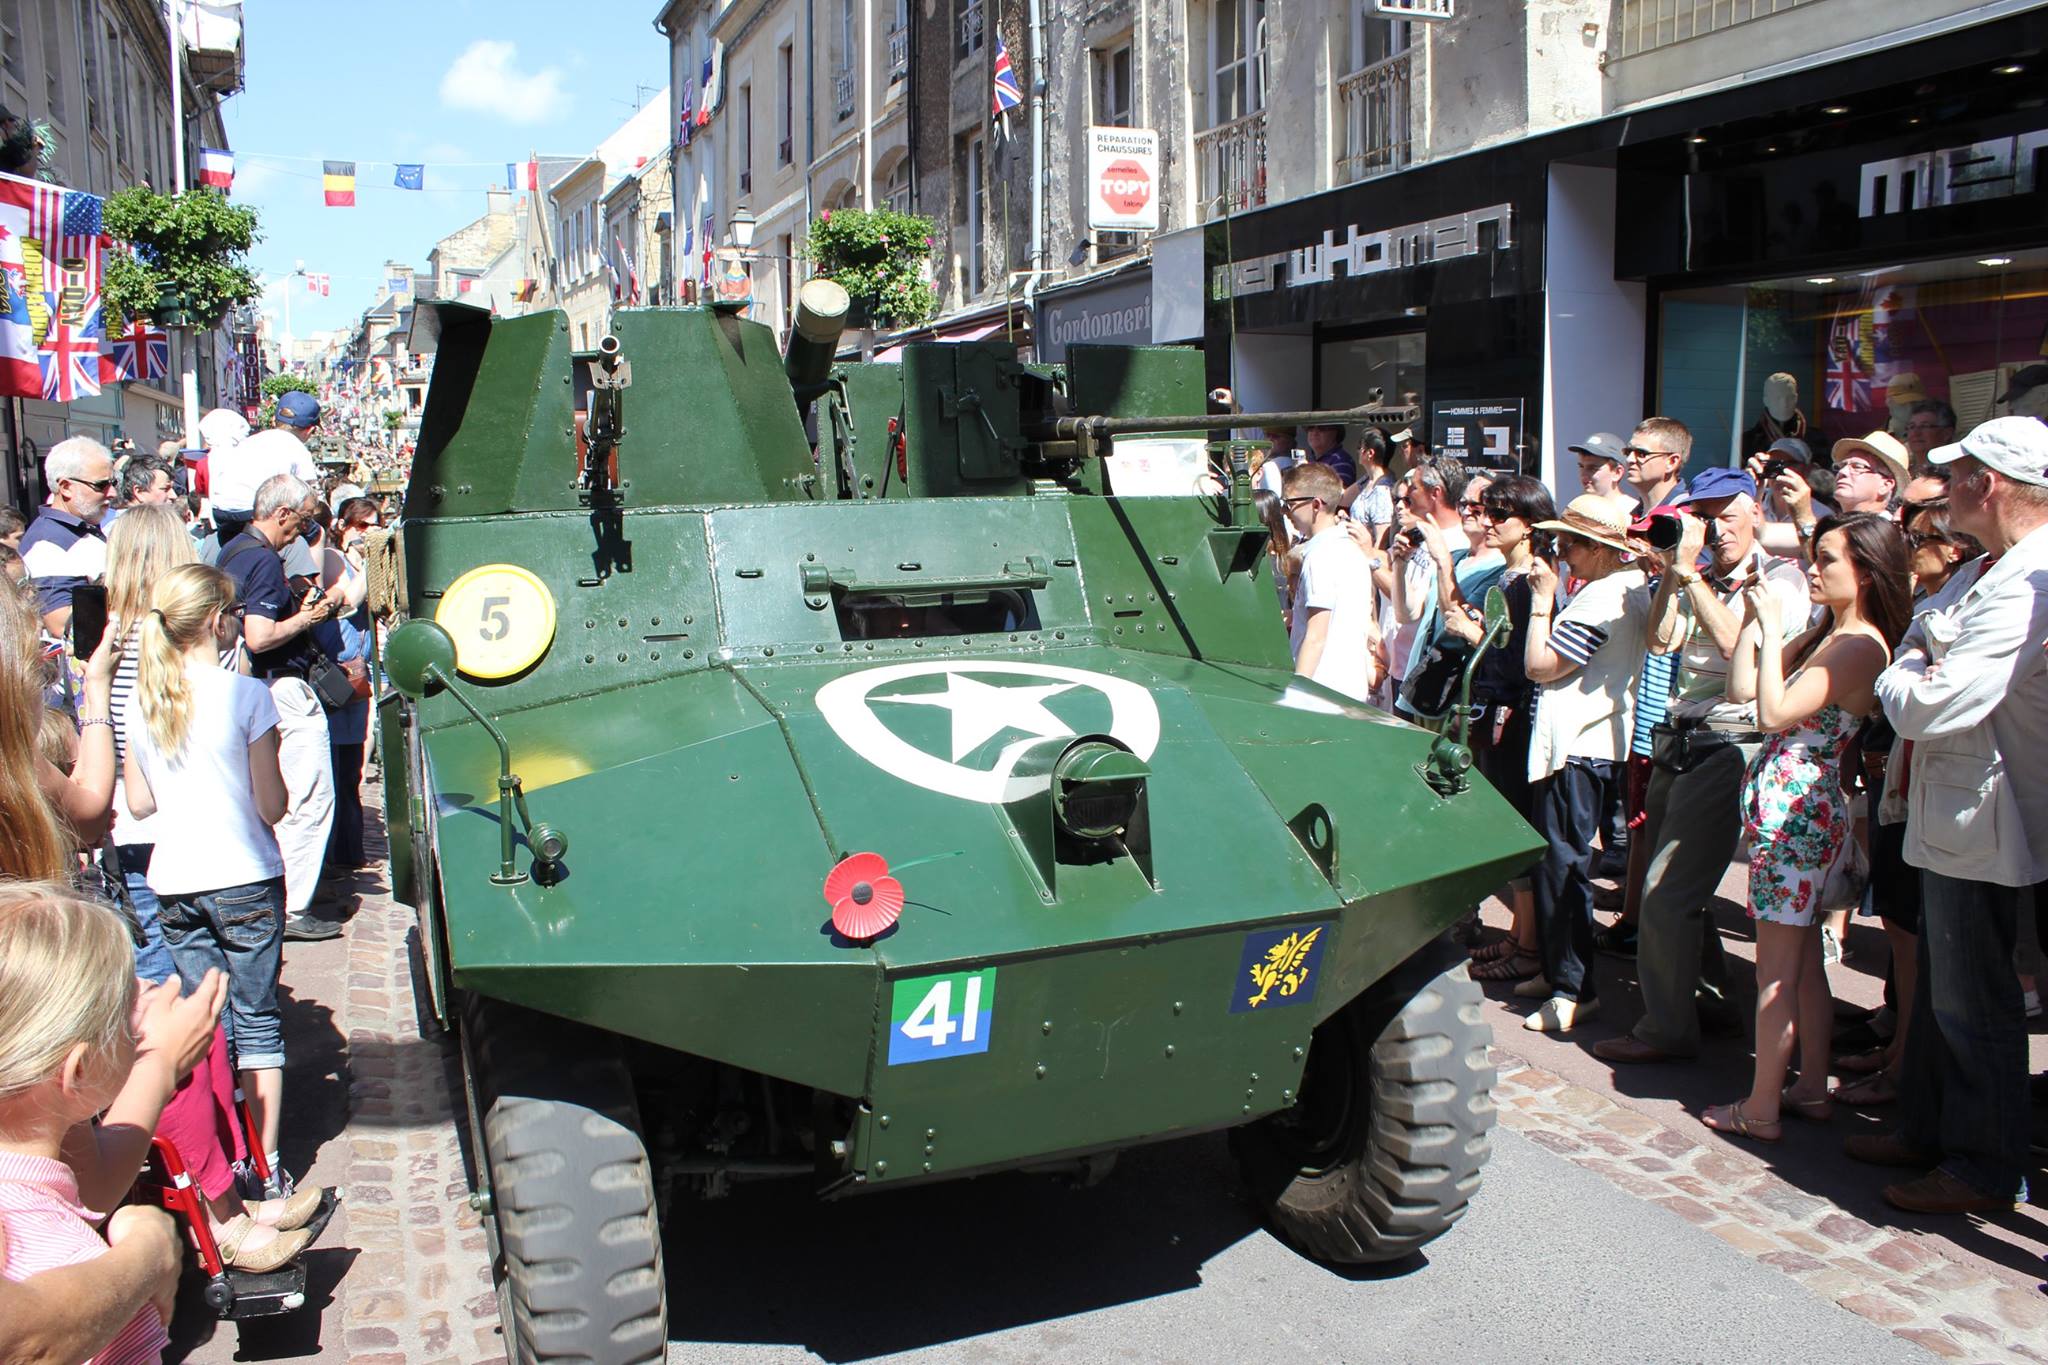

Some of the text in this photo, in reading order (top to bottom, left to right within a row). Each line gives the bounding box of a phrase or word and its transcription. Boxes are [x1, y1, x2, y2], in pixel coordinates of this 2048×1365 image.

[1097, 144, 1153, 156] CHAUSSURES
[1101, 179, 1151, 196] TOPY
[61, 257, 88, 328] D-DAY
[245, 343, 259, 399] HOTEL
[1450, 407, 1474, 416] HOMMES
[1479, 406, 1503, 415] FEMMES
[480, 596, 510, 641] 5
[900, 976, 982, 1046] 41
